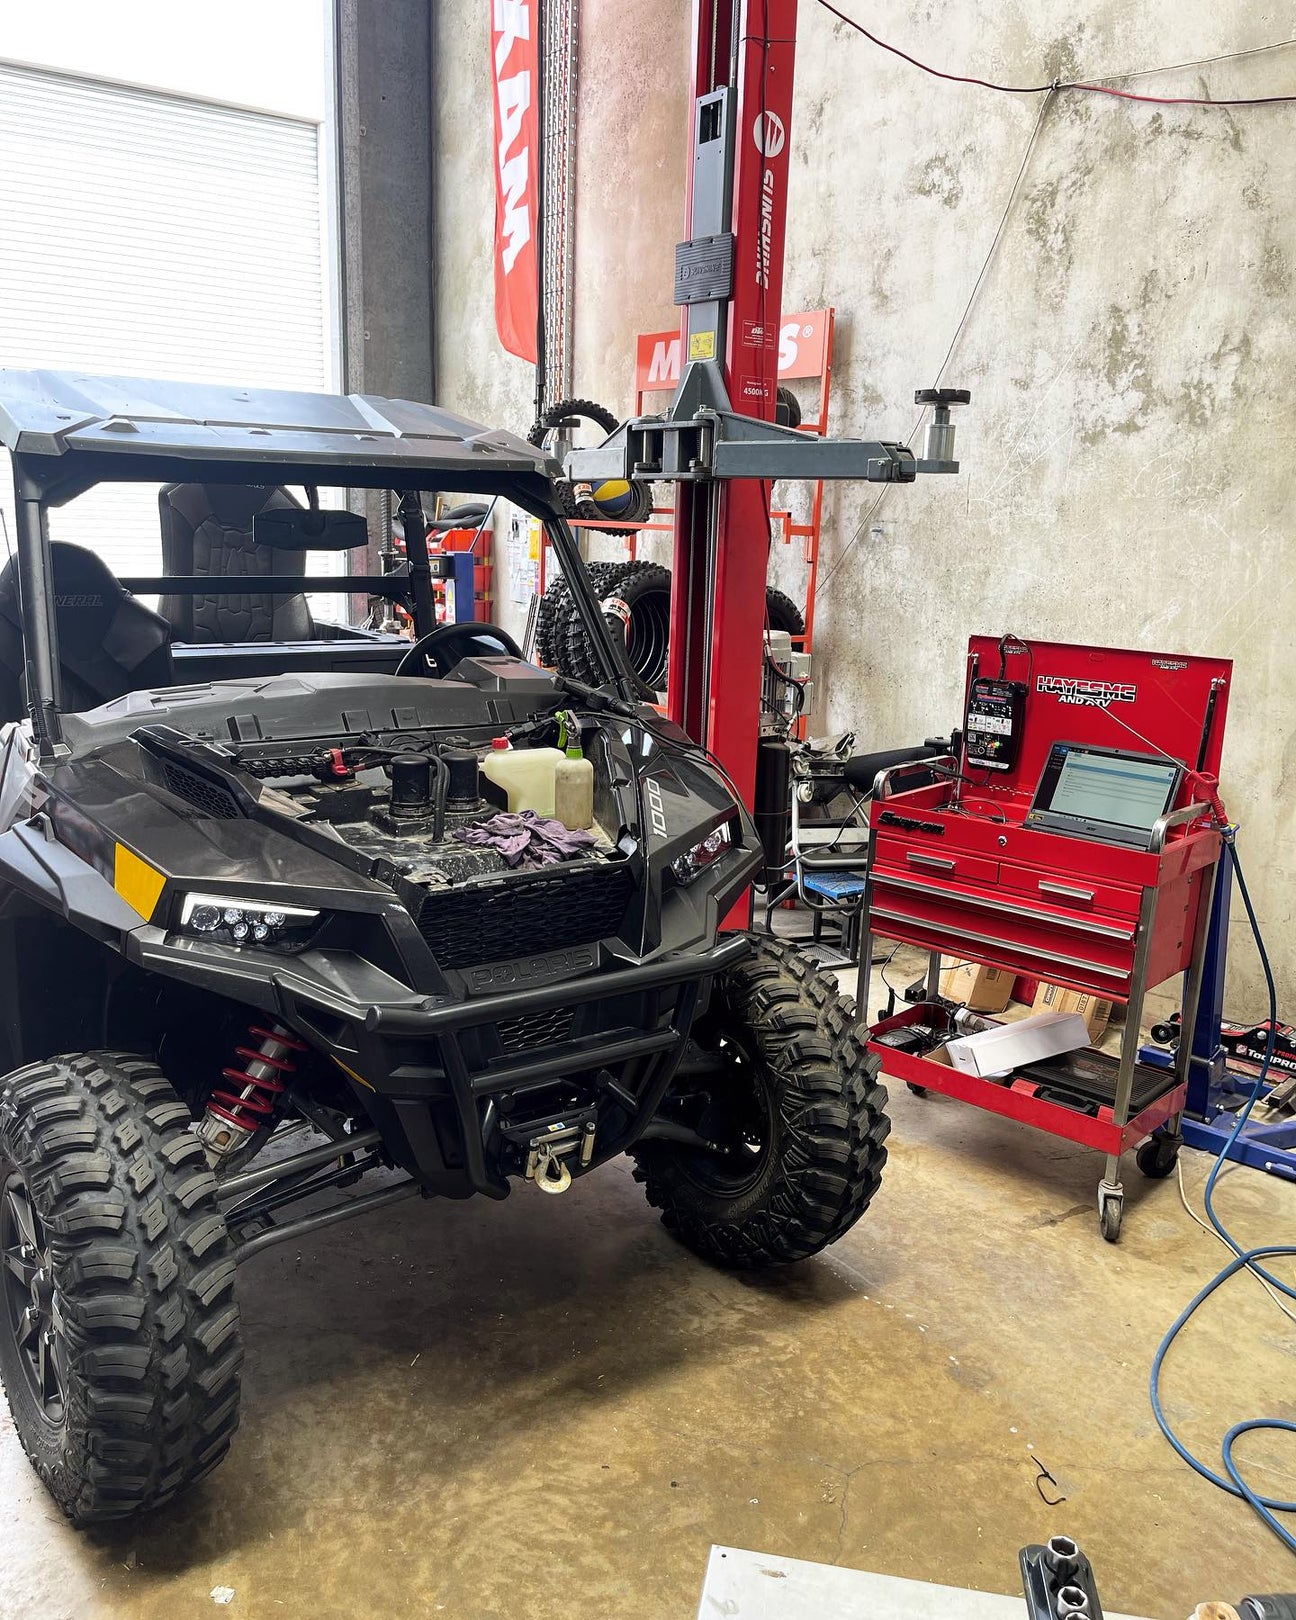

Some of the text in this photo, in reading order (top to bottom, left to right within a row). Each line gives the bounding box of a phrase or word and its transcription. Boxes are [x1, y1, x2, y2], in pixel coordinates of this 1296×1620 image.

[1036, 675, 1137, 703] HAYESMC
[1058, 694, 1085, 705] AND
[646, 777, 668, 839] 1000
[472, 949, 595, 991] POLARIS
